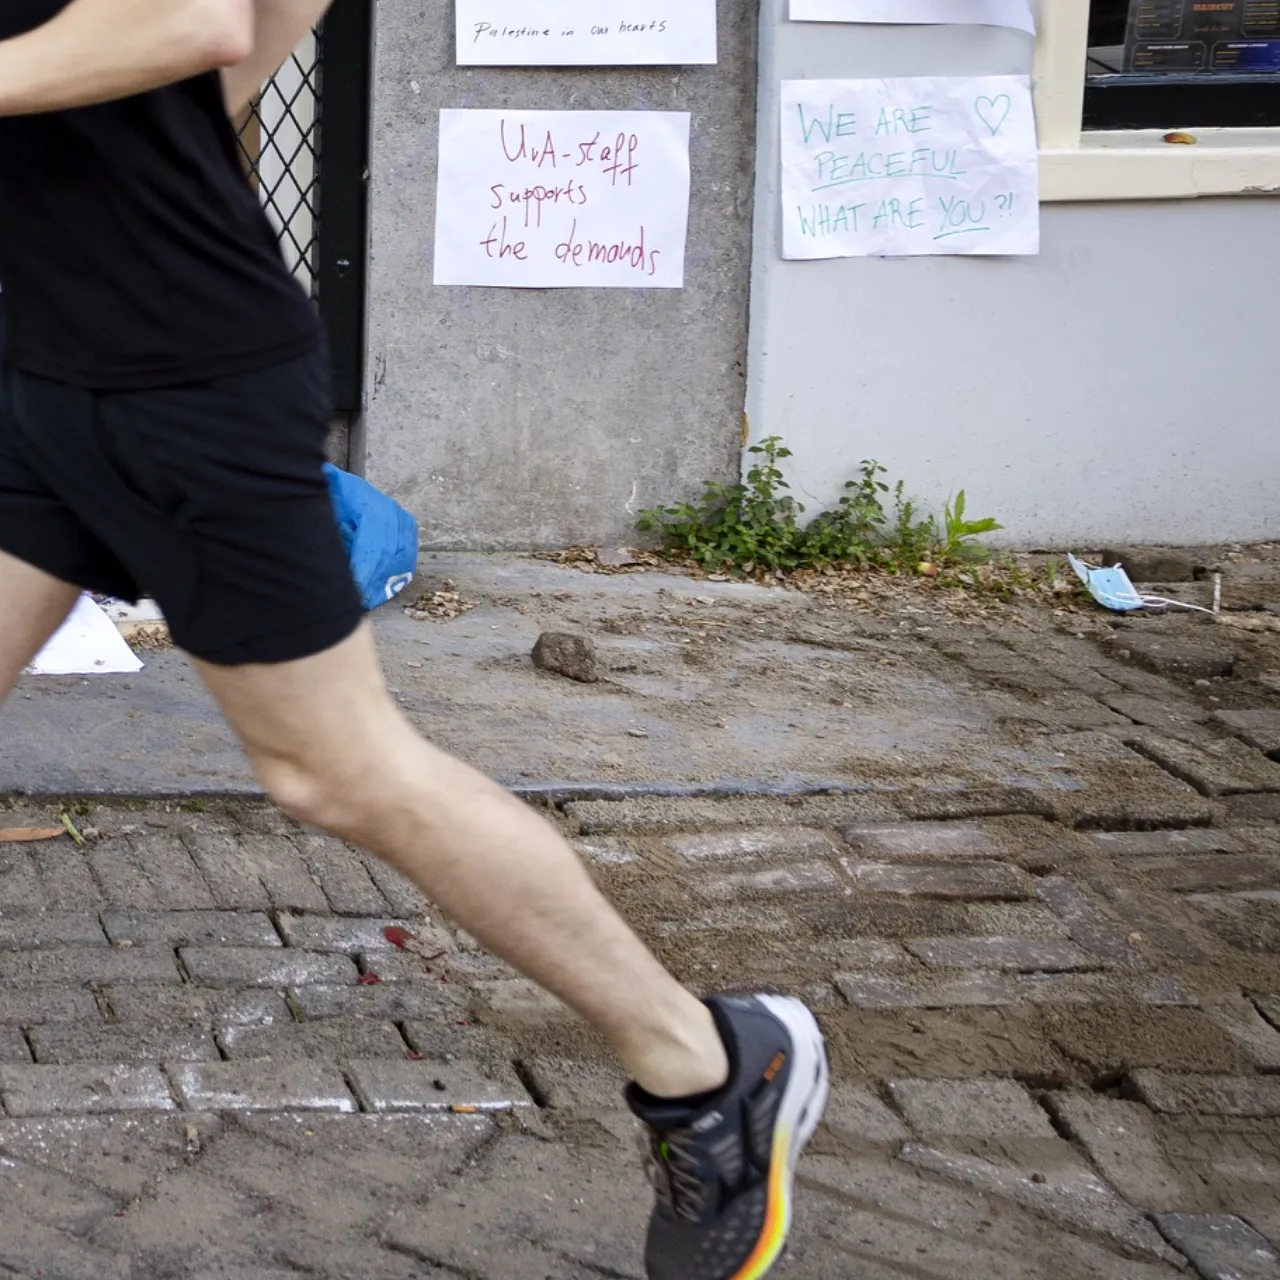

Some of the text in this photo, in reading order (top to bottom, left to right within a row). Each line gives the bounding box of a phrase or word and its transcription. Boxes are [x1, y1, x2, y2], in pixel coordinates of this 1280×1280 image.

[474, 21, 550, 42] Palestine
[798, 103, 932, 144] WE ARE
[813, 149, 966, 180] PEACEFUL
[797, 197, 925, 238] WHAT ARE
[480, 216, 660, 276] the demands
